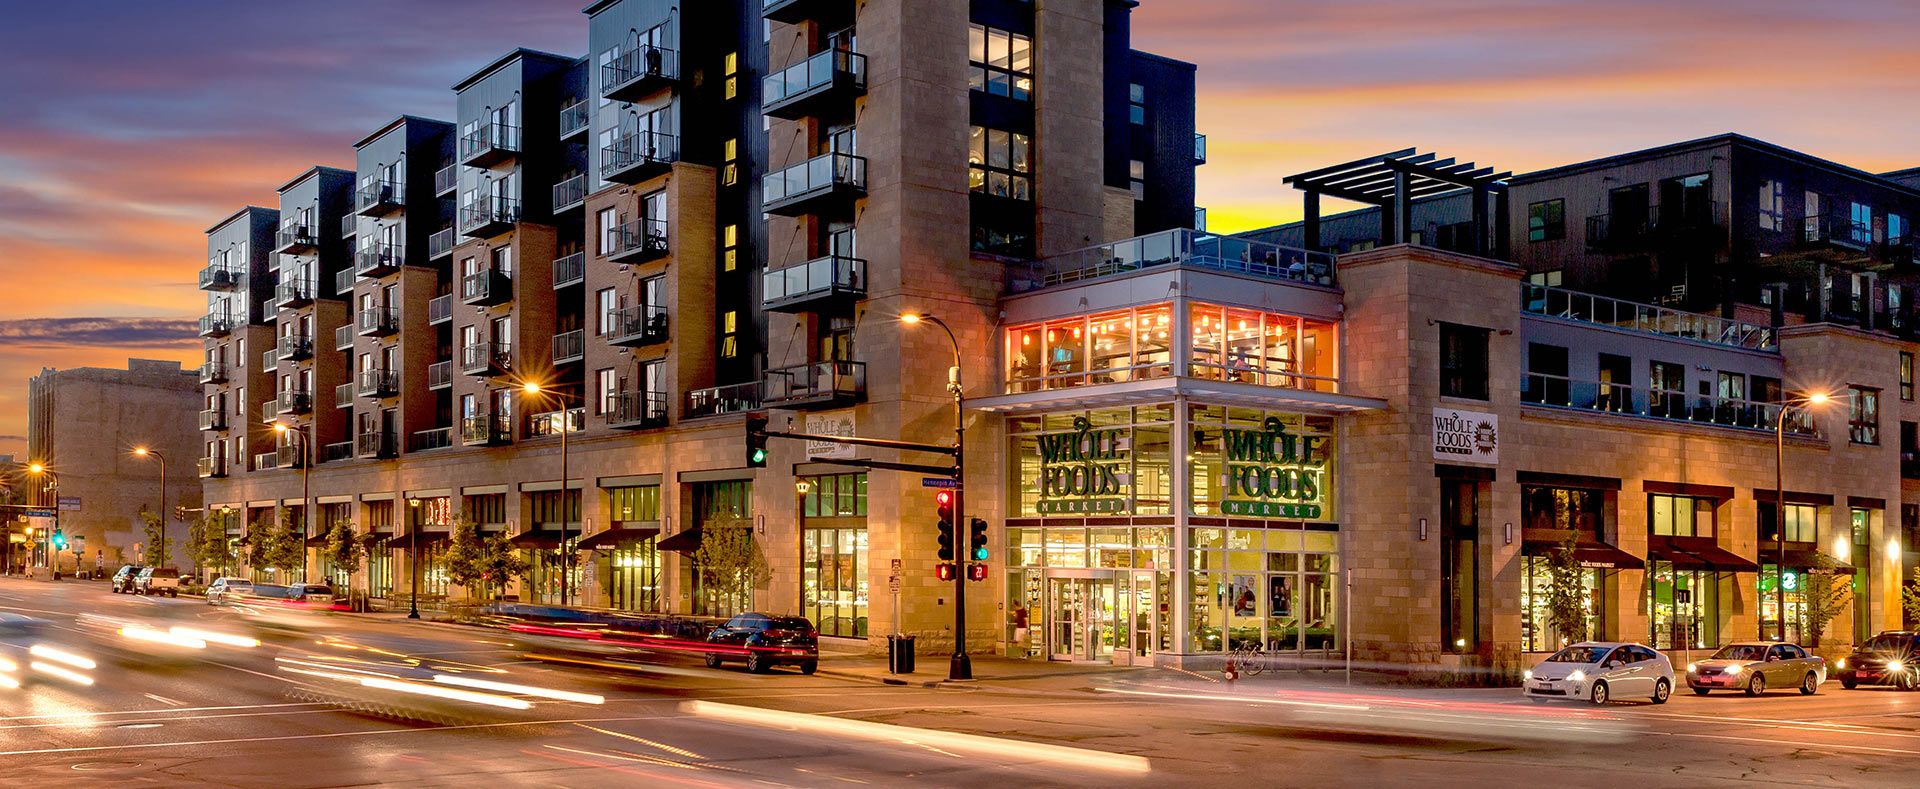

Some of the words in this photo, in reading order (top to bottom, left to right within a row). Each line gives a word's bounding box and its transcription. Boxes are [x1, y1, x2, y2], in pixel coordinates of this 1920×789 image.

[1435, 413, 1473, 434] WHOLE
[1036, 417, 1124, 463] WHOLE
[1222, 417, 1321, 465] WHOLE
[1437, 431, 1472, 448] FOODS
[1041, 464, 1120, 496] FOODS
[1228, 464, 1318, 500] FOODS
[1041, 501, 1116, 511] MARKET
[1231, 503, 1315, 516] MARKET
